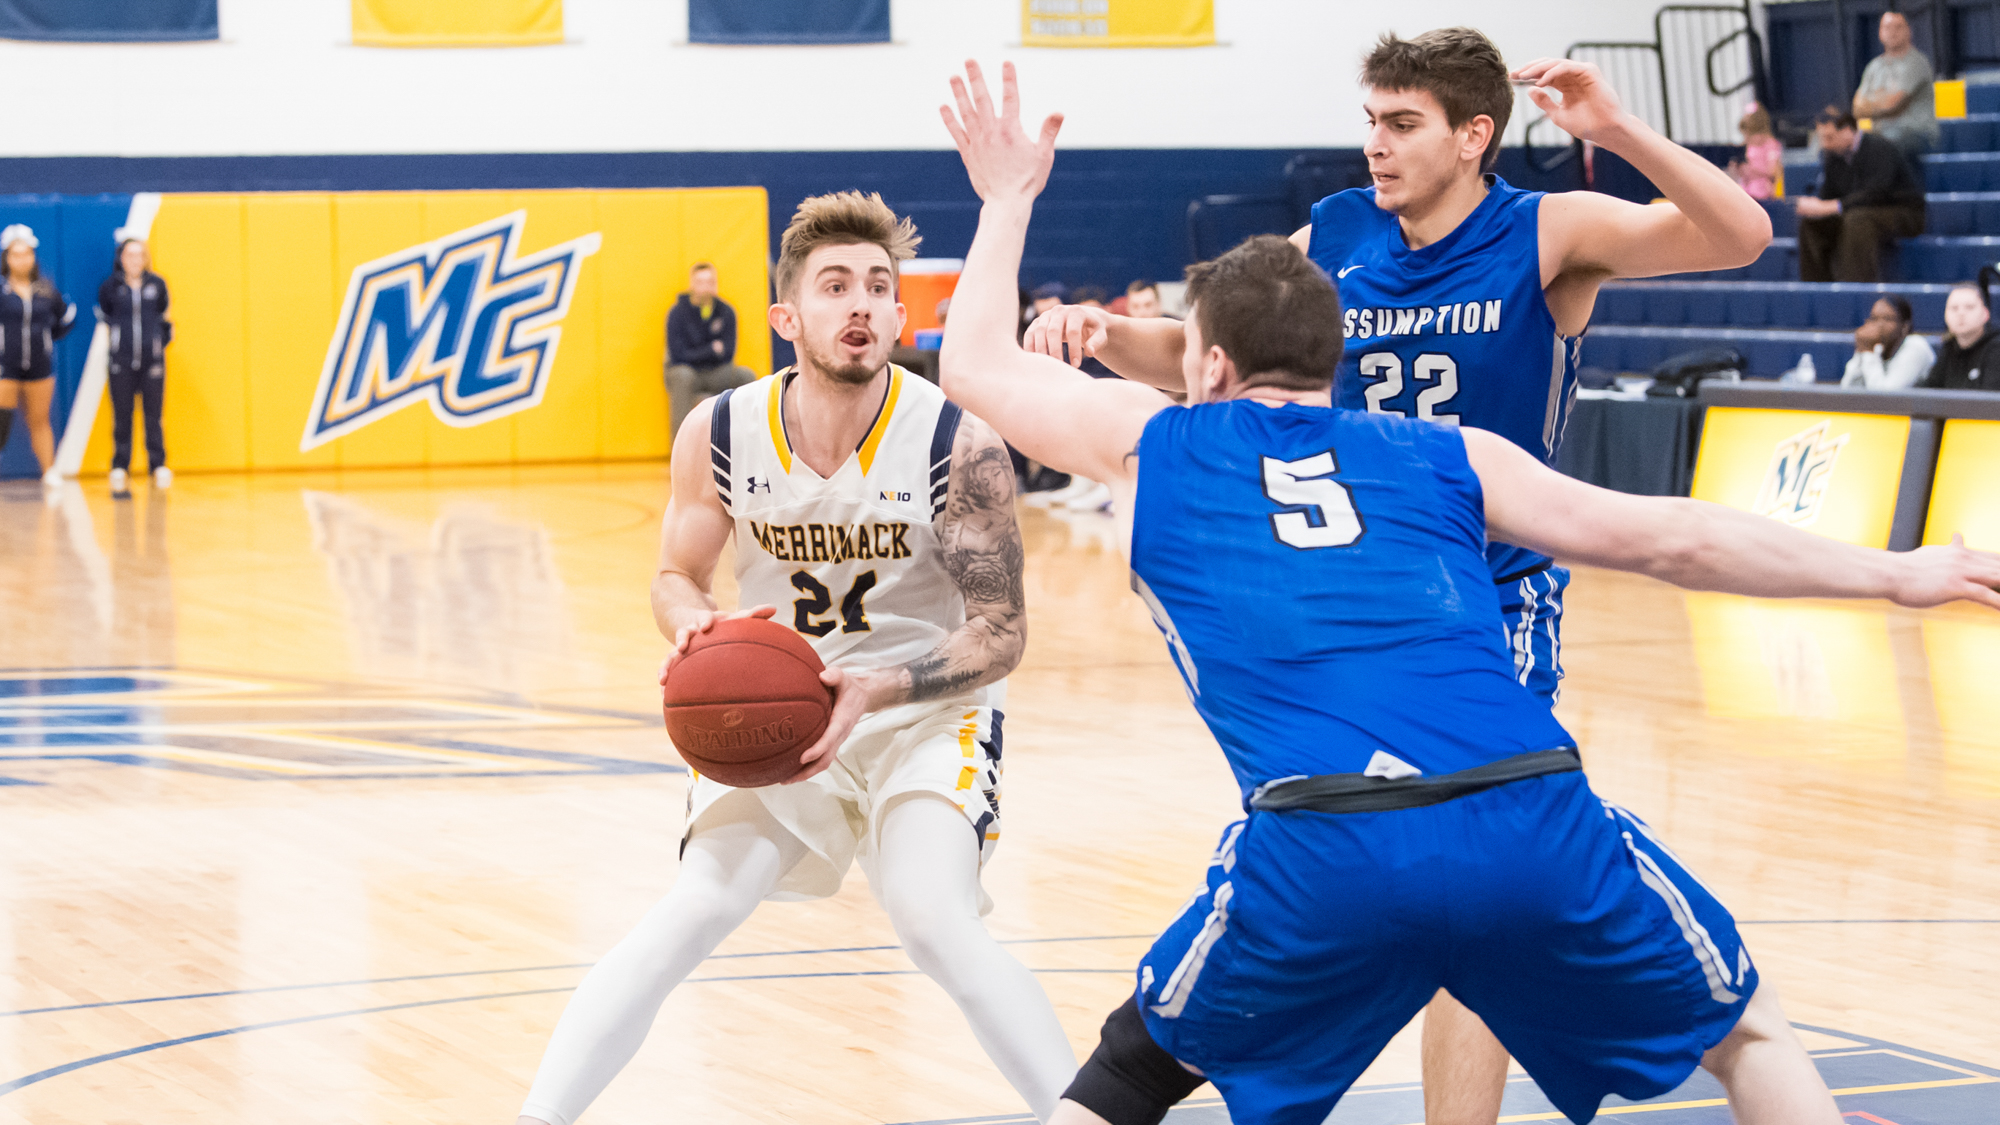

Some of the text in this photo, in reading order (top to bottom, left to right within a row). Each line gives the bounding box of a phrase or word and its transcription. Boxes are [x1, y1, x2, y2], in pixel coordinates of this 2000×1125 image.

[310, 220, 580, 438] MC
[1342, 298, 1503, 340] SSUMPTION
[1358, 350, 1461, 427] 22
[1260, 448, 1366, 551] 5
[1757, 425, 1842, 524] MC
[750, 519, 912, 564] MERRIMACK
[684, 715, 795, 748] SPALDING
